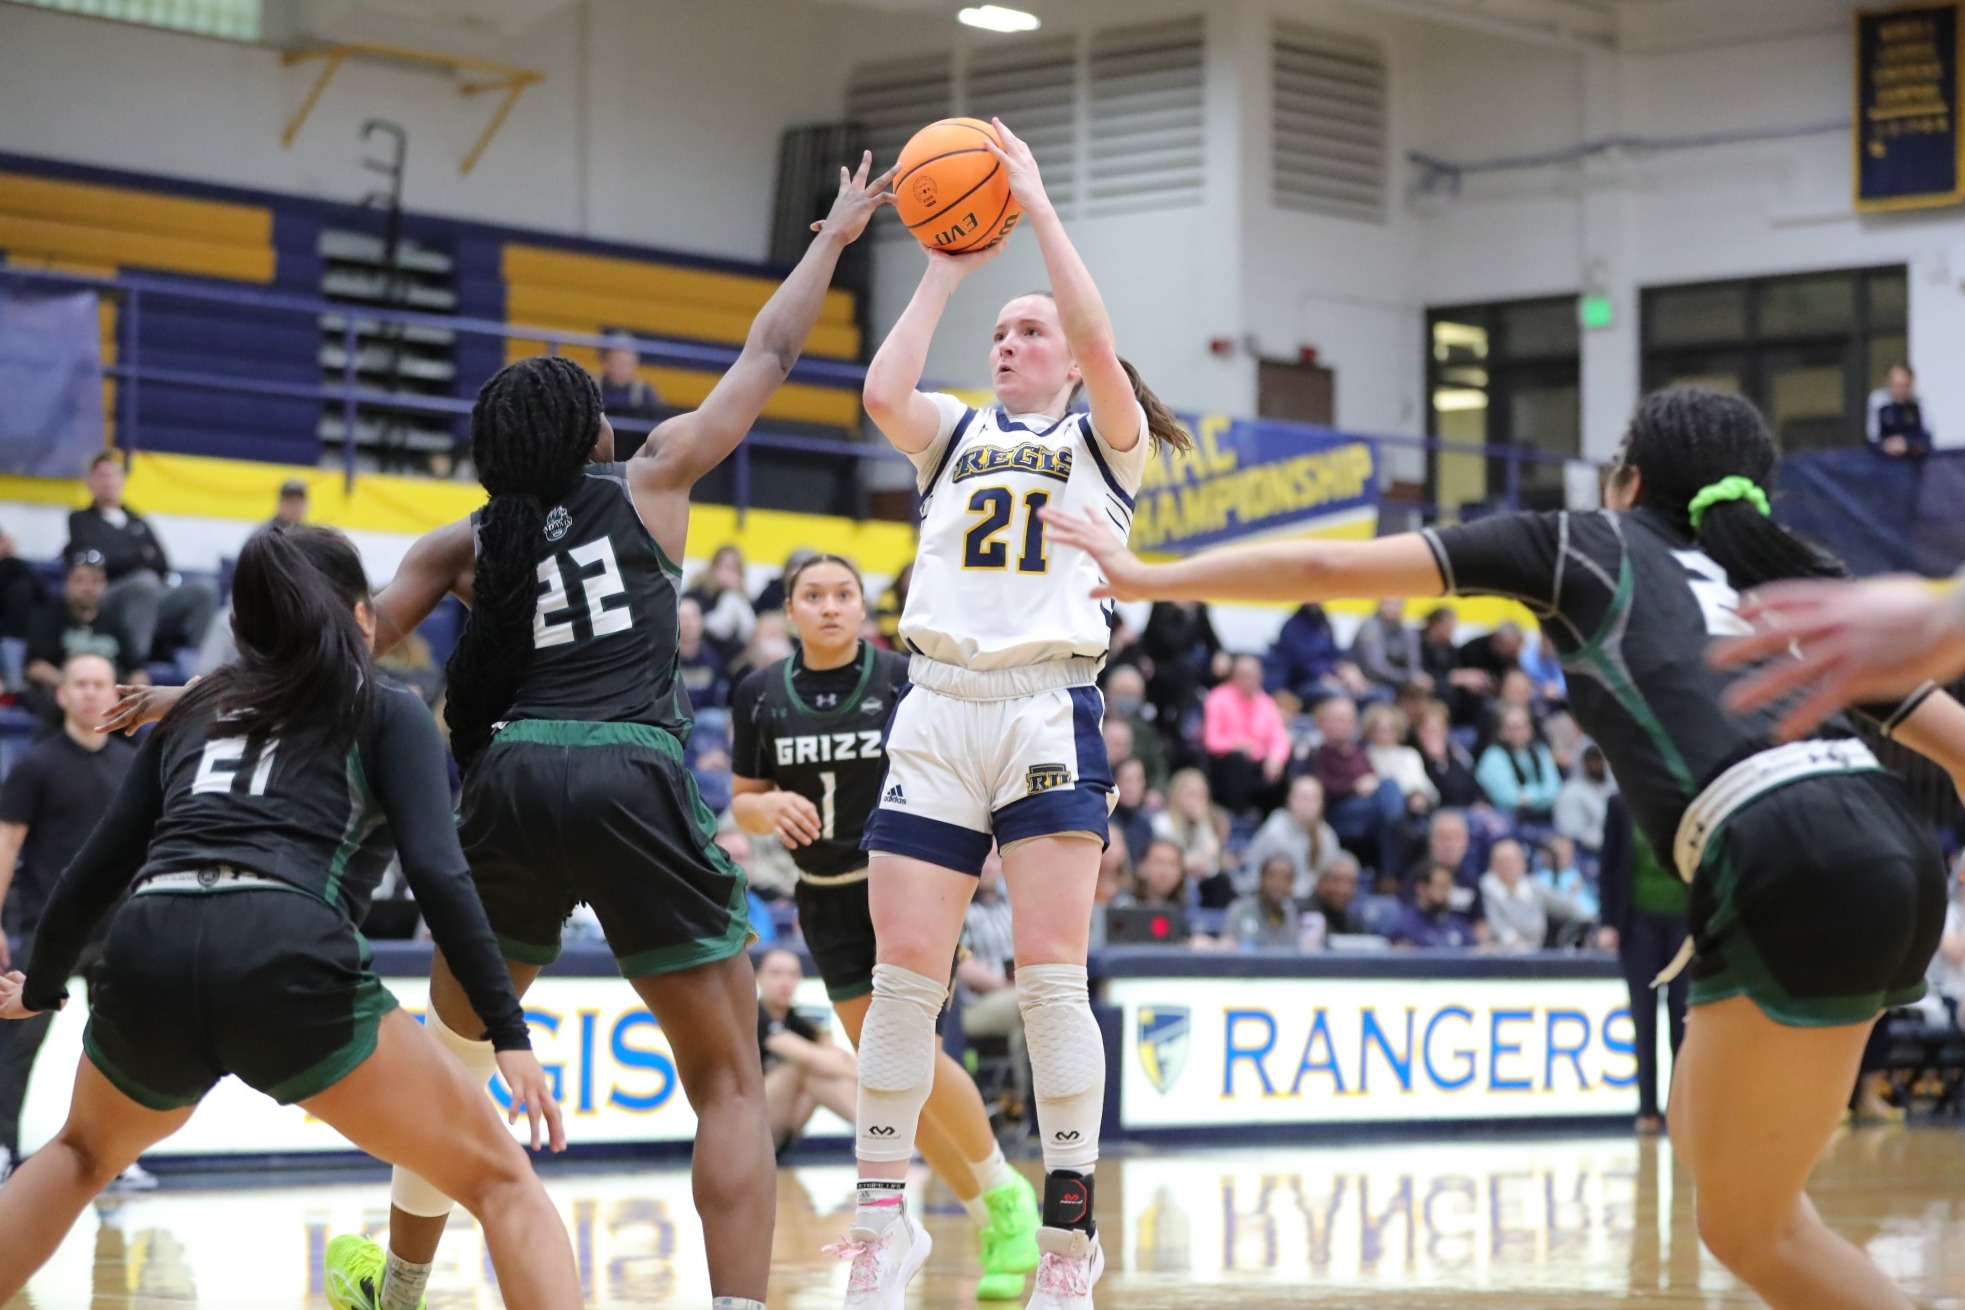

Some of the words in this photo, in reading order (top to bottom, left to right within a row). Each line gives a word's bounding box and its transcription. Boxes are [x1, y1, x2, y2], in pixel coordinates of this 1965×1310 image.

[953, 442, 1073, 483] REGIS
[961, 484, 1051, 575] 21
[532, 535, 633, 650] 22
[774, 730, 882, 766] GRIZZ
[819, 772, 836, 839] 1
[883, 796, 907, 805] adidas
[1220, 1005, 1639, 1098] RANGERS
